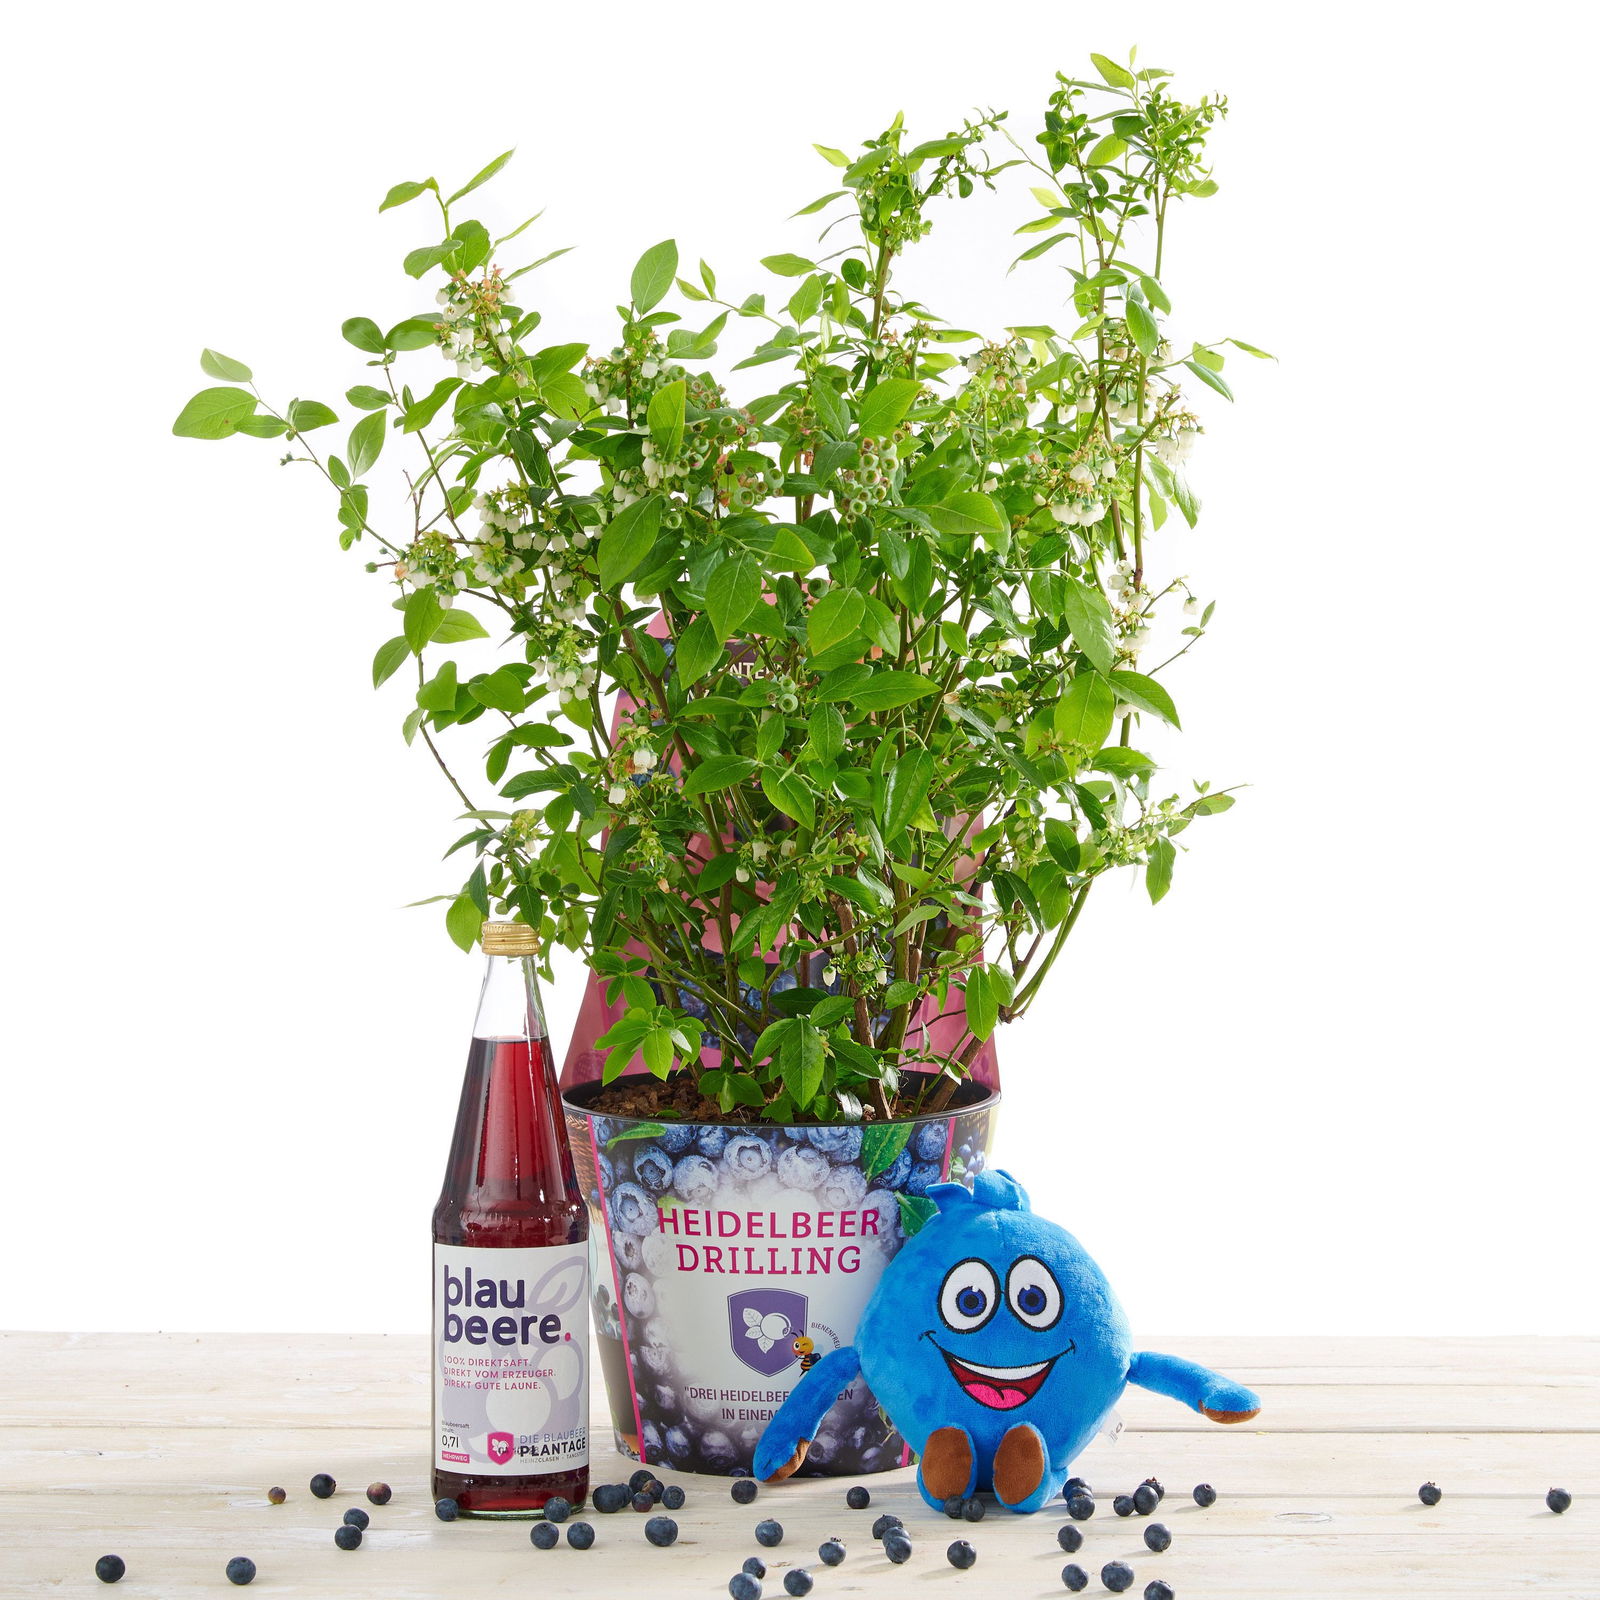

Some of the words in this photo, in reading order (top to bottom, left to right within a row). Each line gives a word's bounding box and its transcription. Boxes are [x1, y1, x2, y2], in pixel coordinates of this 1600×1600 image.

[657, 1207, 879, 1238] HEIDELBEER
[676, 1244, 861, 1274] DRILLING
[444, 1264, 525, 1309] blau
[444, 1307, 571, 1346] beere.
[811, 1322, 841, 1349] BIENENFREU
[444, 1355, 465, 1366] 100%
[468, 1358, 532, 1367] DIREKTSAFT.
[444, 1367, 472, 1378] DIREKT
[475, 1370, 499, 1379] VOM
[502, 1368, 556, 1379] ERZEUGER.
[444, 1378, 472, 1389] DIREKT
[475, 1381, 501, 1390] GUTE
[504, 1381, 541, 1390] LAUNE.
[721, 1408, 735, 1420] IN
[520, 1434, 540, 1445] DIE
[520, 1436, 586, 1457] PLANTAGE
